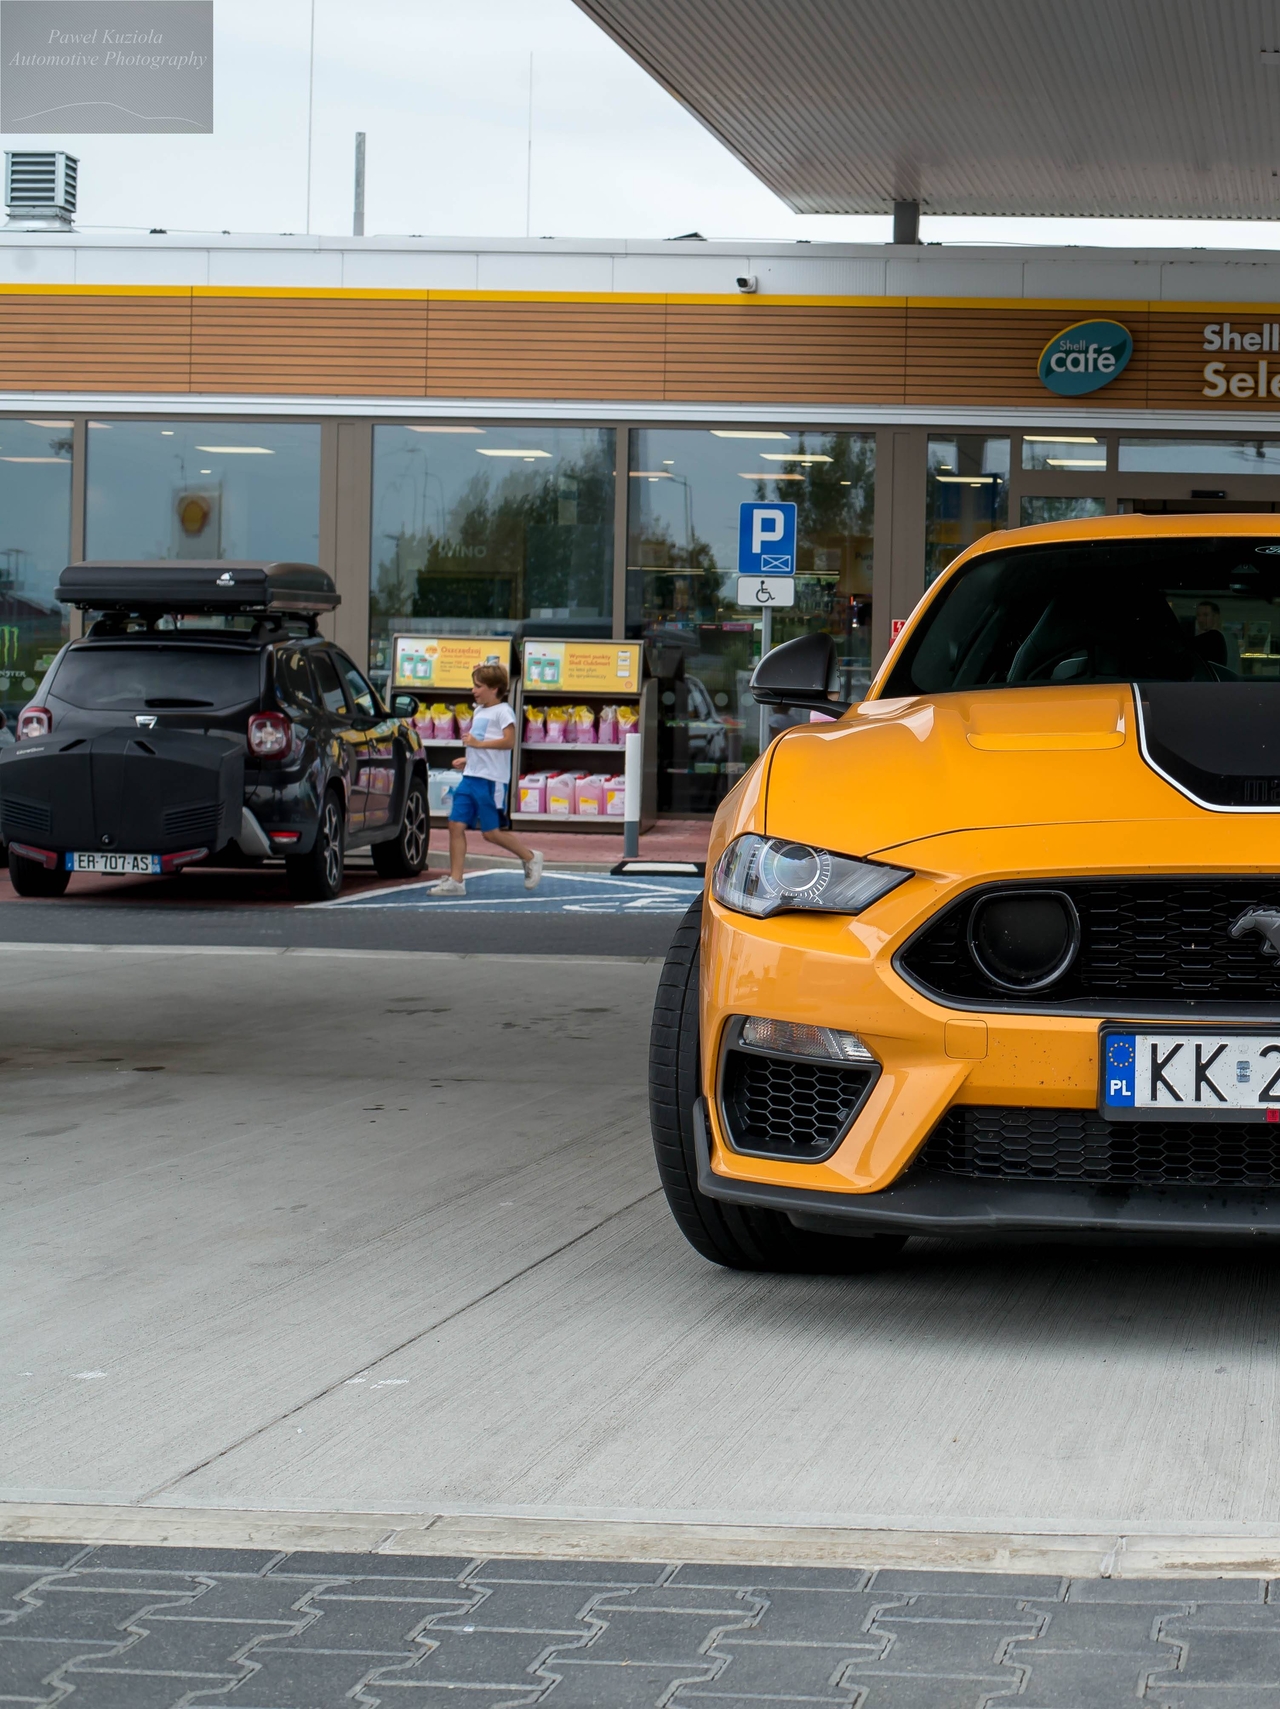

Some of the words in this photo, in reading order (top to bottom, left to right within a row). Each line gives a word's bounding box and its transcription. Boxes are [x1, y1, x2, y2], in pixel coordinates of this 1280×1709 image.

[1060, 340, 1086, 350] Shell
[1202, 322, 1280, 351] Shell
[1050, 343, 1116, 373] café
[752, 509, 784, 553] P
[1150, 1042, 1228, 1102] KK
[1110, 1080, 1131, 1096] PL
